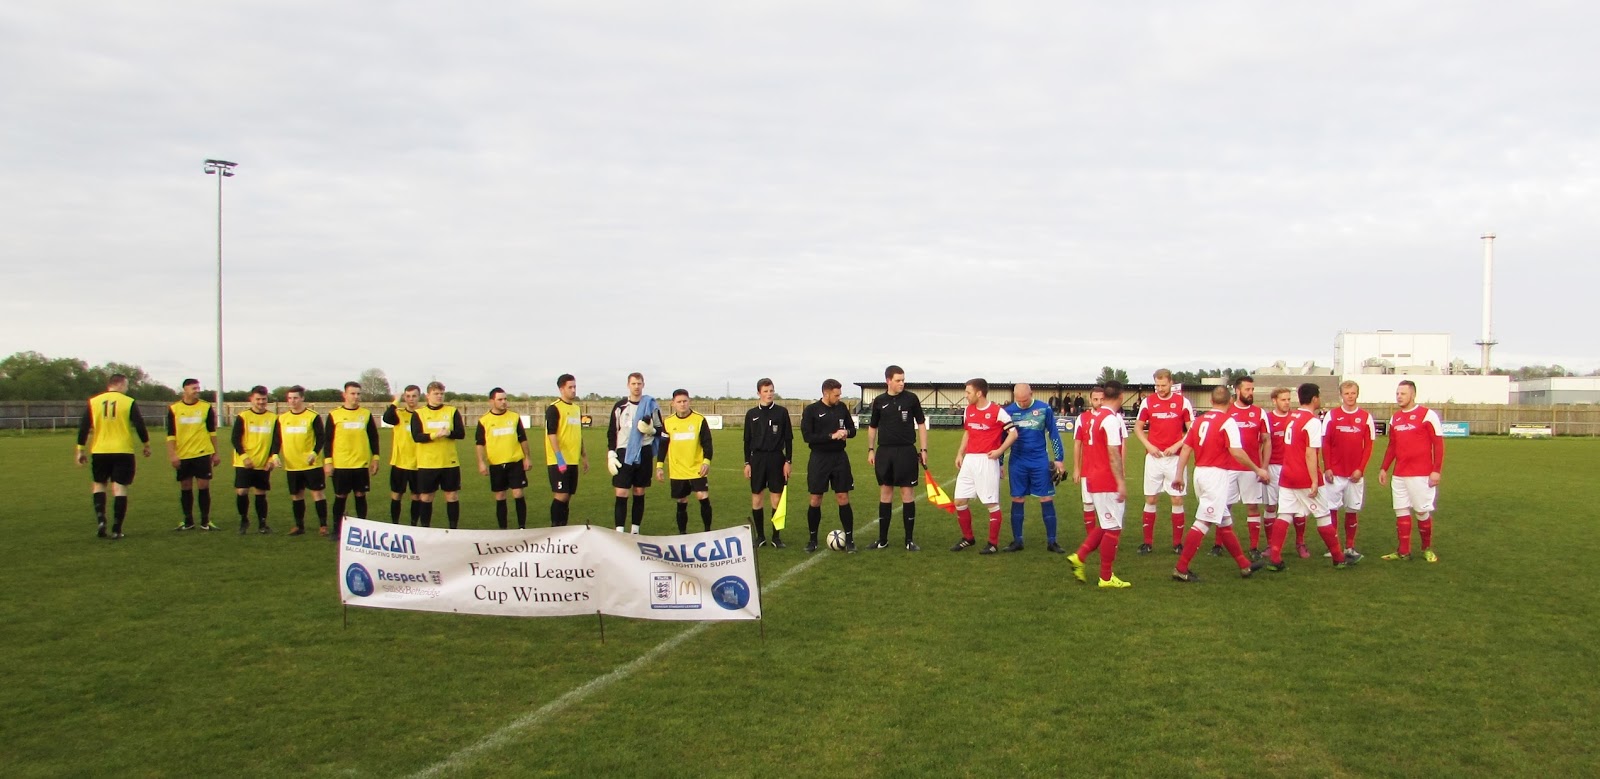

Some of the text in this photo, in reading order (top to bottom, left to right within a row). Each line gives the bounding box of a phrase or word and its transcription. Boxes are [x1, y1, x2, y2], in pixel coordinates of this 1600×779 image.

[102, 400, 117, 419] 11
[1198, 420, 1210, 447] 9
[1284, 420, 1295, 445] 6
[557, 481, 563, 490] 5
[346, 526, 417, 555] BALCAN
[473, 537, 579, 556] Lincolnshire
[637, 536, 743, 563] BALCAN
[345, 545, 421, 561] BALCAN LIGHTING SUPPLIES
[671, 561, 709, 569] LIGHTING
[709, 556, 747, 568] SUPPLIES
[377, 568, 429, 584] Respect
[469, 561, 596, 583] Football League
[474, 584, 590, 605] Cup Winners
